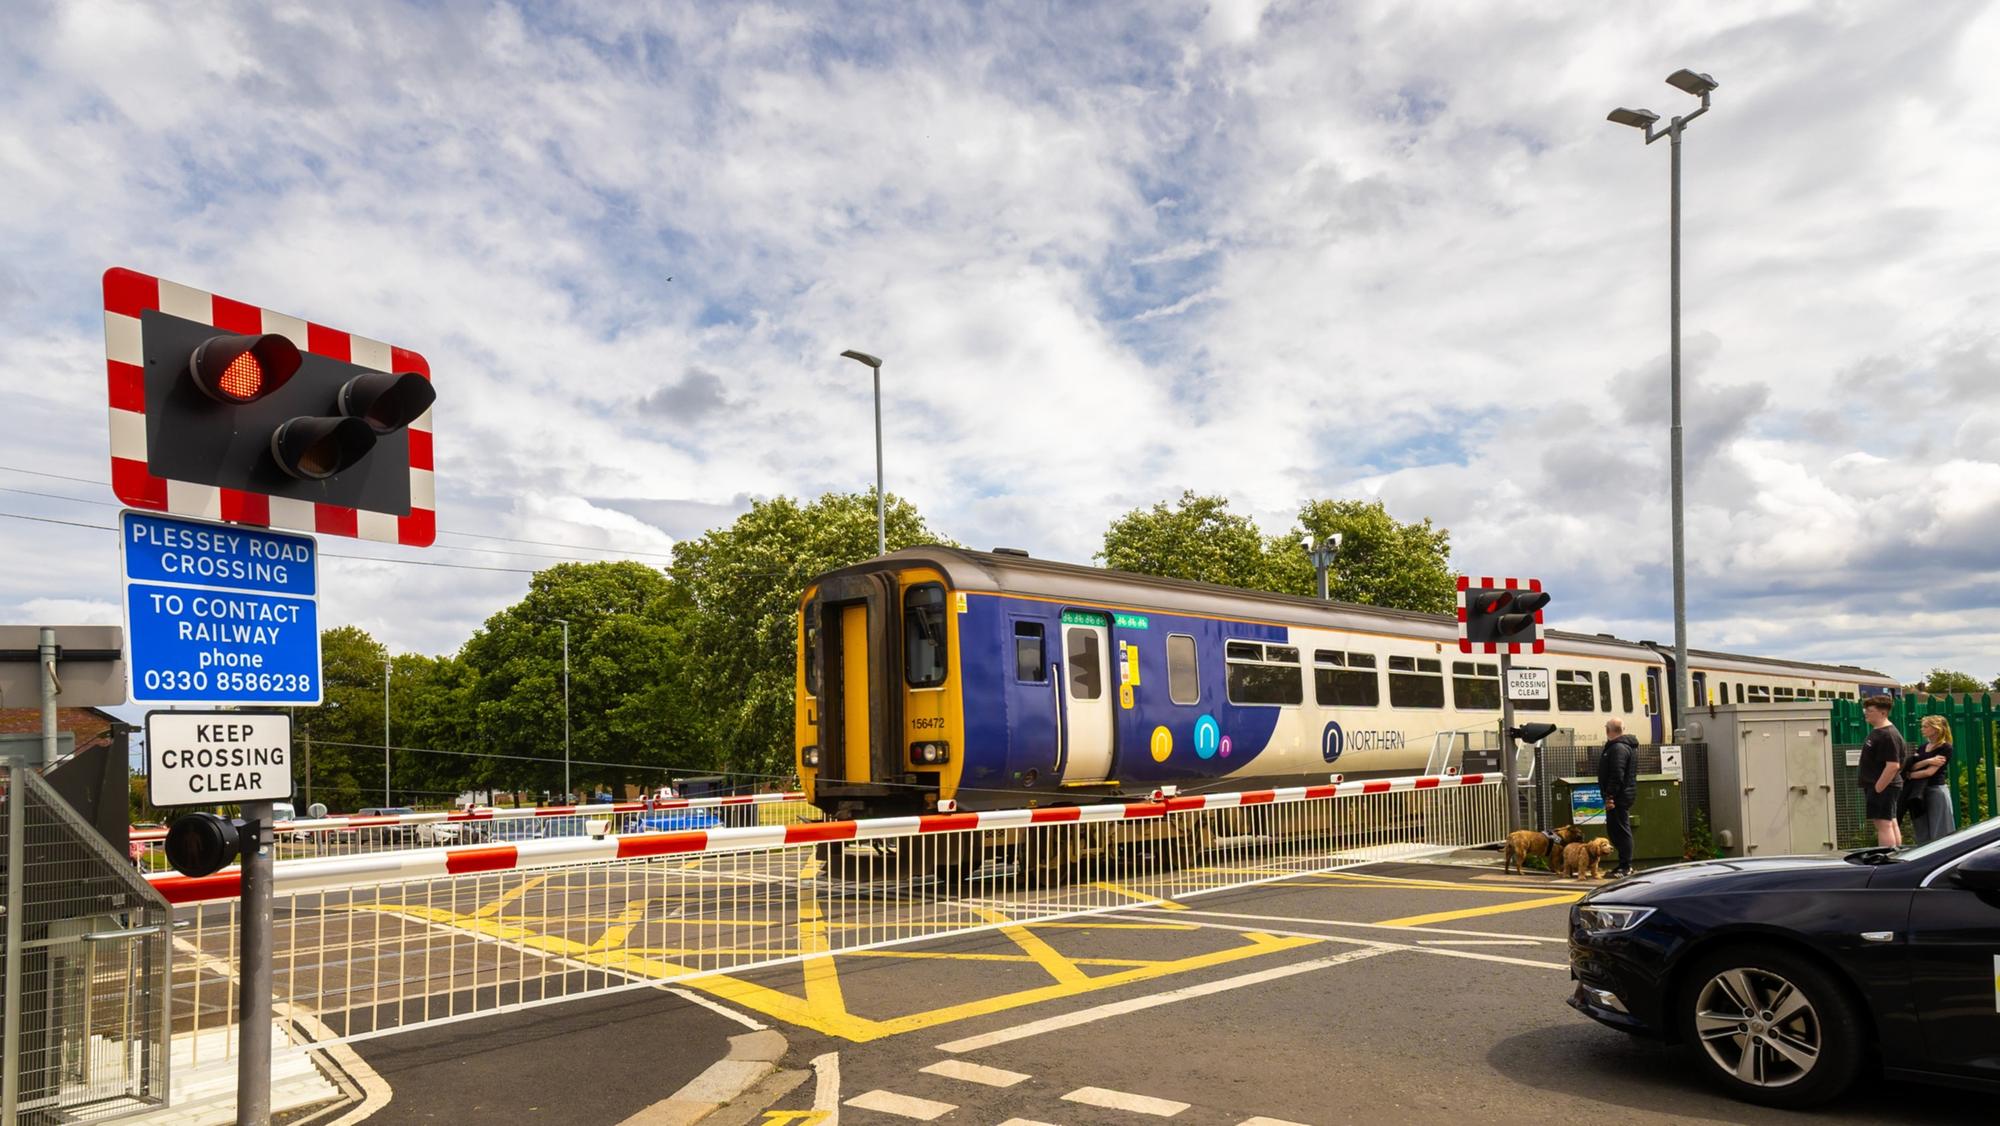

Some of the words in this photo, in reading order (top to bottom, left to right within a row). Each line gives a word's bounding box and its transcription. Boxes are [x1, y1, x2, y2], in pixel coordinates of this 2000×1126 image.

[133, 523, 241, 555] PLESSEY
[250, 540, 310, 563] ROAD
[161, 553, 288, 584] CROSSING
[150, 594, 184, 615] TO
[192, 597, 300, 624] CONTACT
[179, 621, 280, 645] RAILWAY
[200, 648, 263, 669] phone
[144, 670, 208, 691] 0330
[216, 672, 311, 693] 8586238
[1510, 680, 1546, 688] CROSSING
[1519, 672, 1537, 680] KEEP
[1517, 688, 1540, 696] CLEAR
[196, 724, 254, 743] KEEP
[911, 717, 945, 729] 156472
[1345, 730, 1405, 751] NORTHERN
[161, 747, 285, 769] CROSSING
[188, 772, 263, 793] CLEAR
